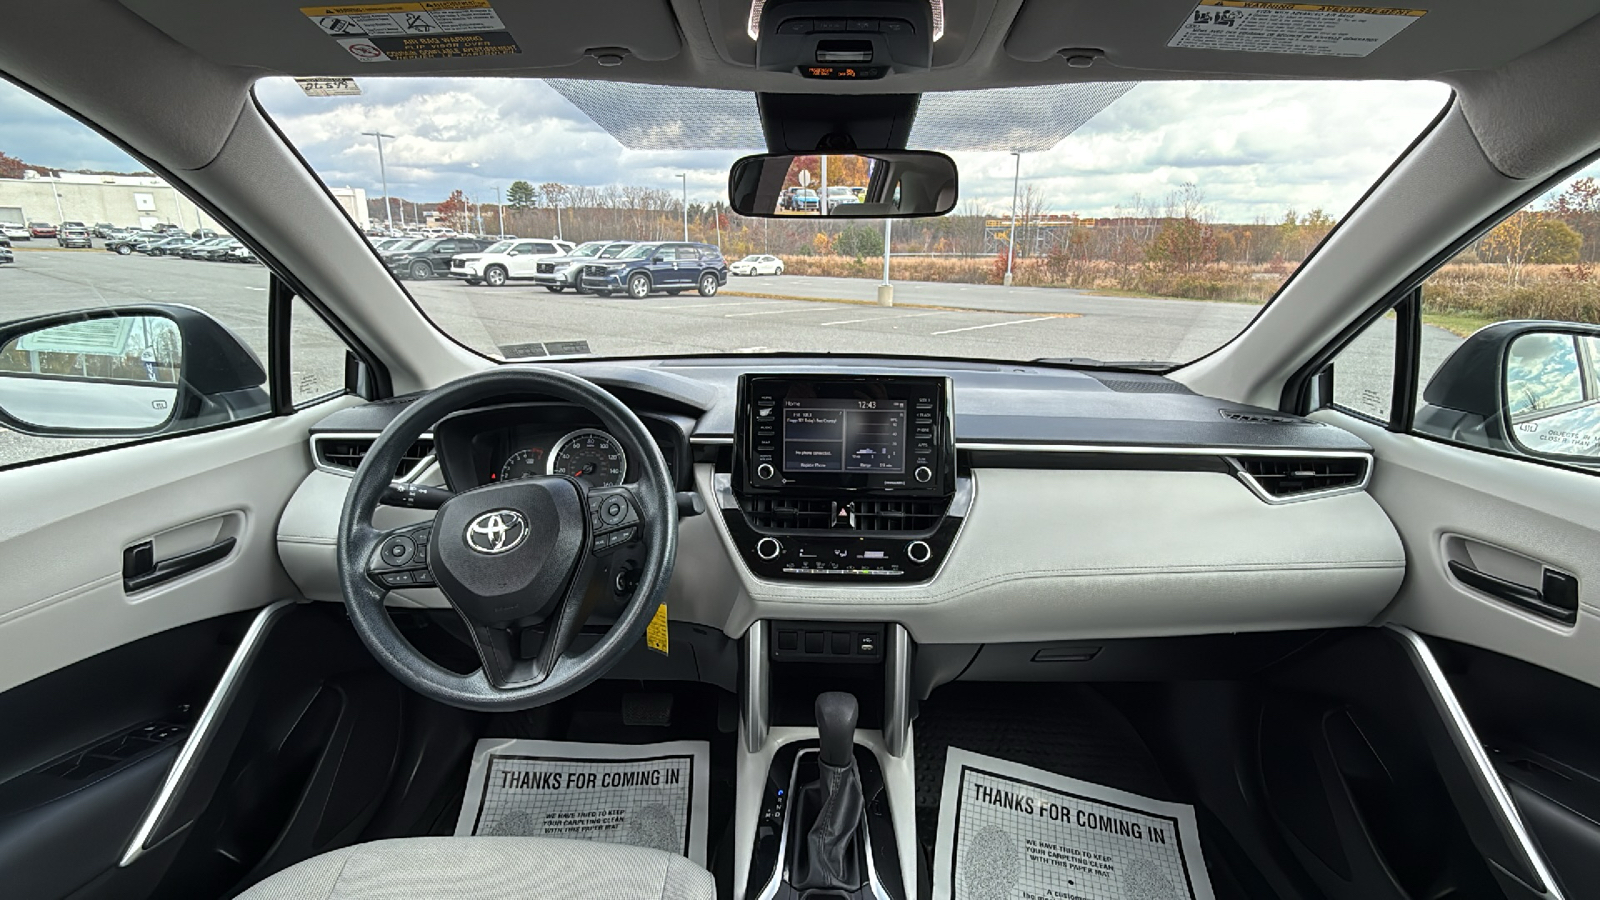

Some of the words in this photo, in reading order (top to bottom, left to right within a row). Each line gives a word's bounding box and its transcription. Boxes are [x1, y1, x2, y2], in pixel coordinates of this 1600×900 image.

[1244, 2, 1294, 10] WARNING
[1318, 6, 1410, 16] AVERTISSEMENT
[1540, 435, 1568, 443] CLOSER
[1548, 430, 1578, 439] OBJECTS
[502, 771, 562, 790] THANKS
[566, 772, 597, 789] FOR
[601, 770, 660, 788] COMING
[665, 768, 680, 784] IN
[974, 783, 1034, 815] THANKS
[1039, 800, 1071, 824] FOR
[1077, 810, 1142, 839] COMING
[1148, 826, 1166, 845] IN
[1039, 842, 1057, 850] HAVE
[1060, 846, 1080, 856] TRIED
[1026, 847, 1045, 856] YOUR
[1048, 851, 1088, 865] CARPETING
[1090, 861, 1114, 871] CLEAN
[1030, 855, 1048, 864] WITH
[1051, 859, 1067, 868] THIS
[1070, 863, 1093, 874] PAPER
